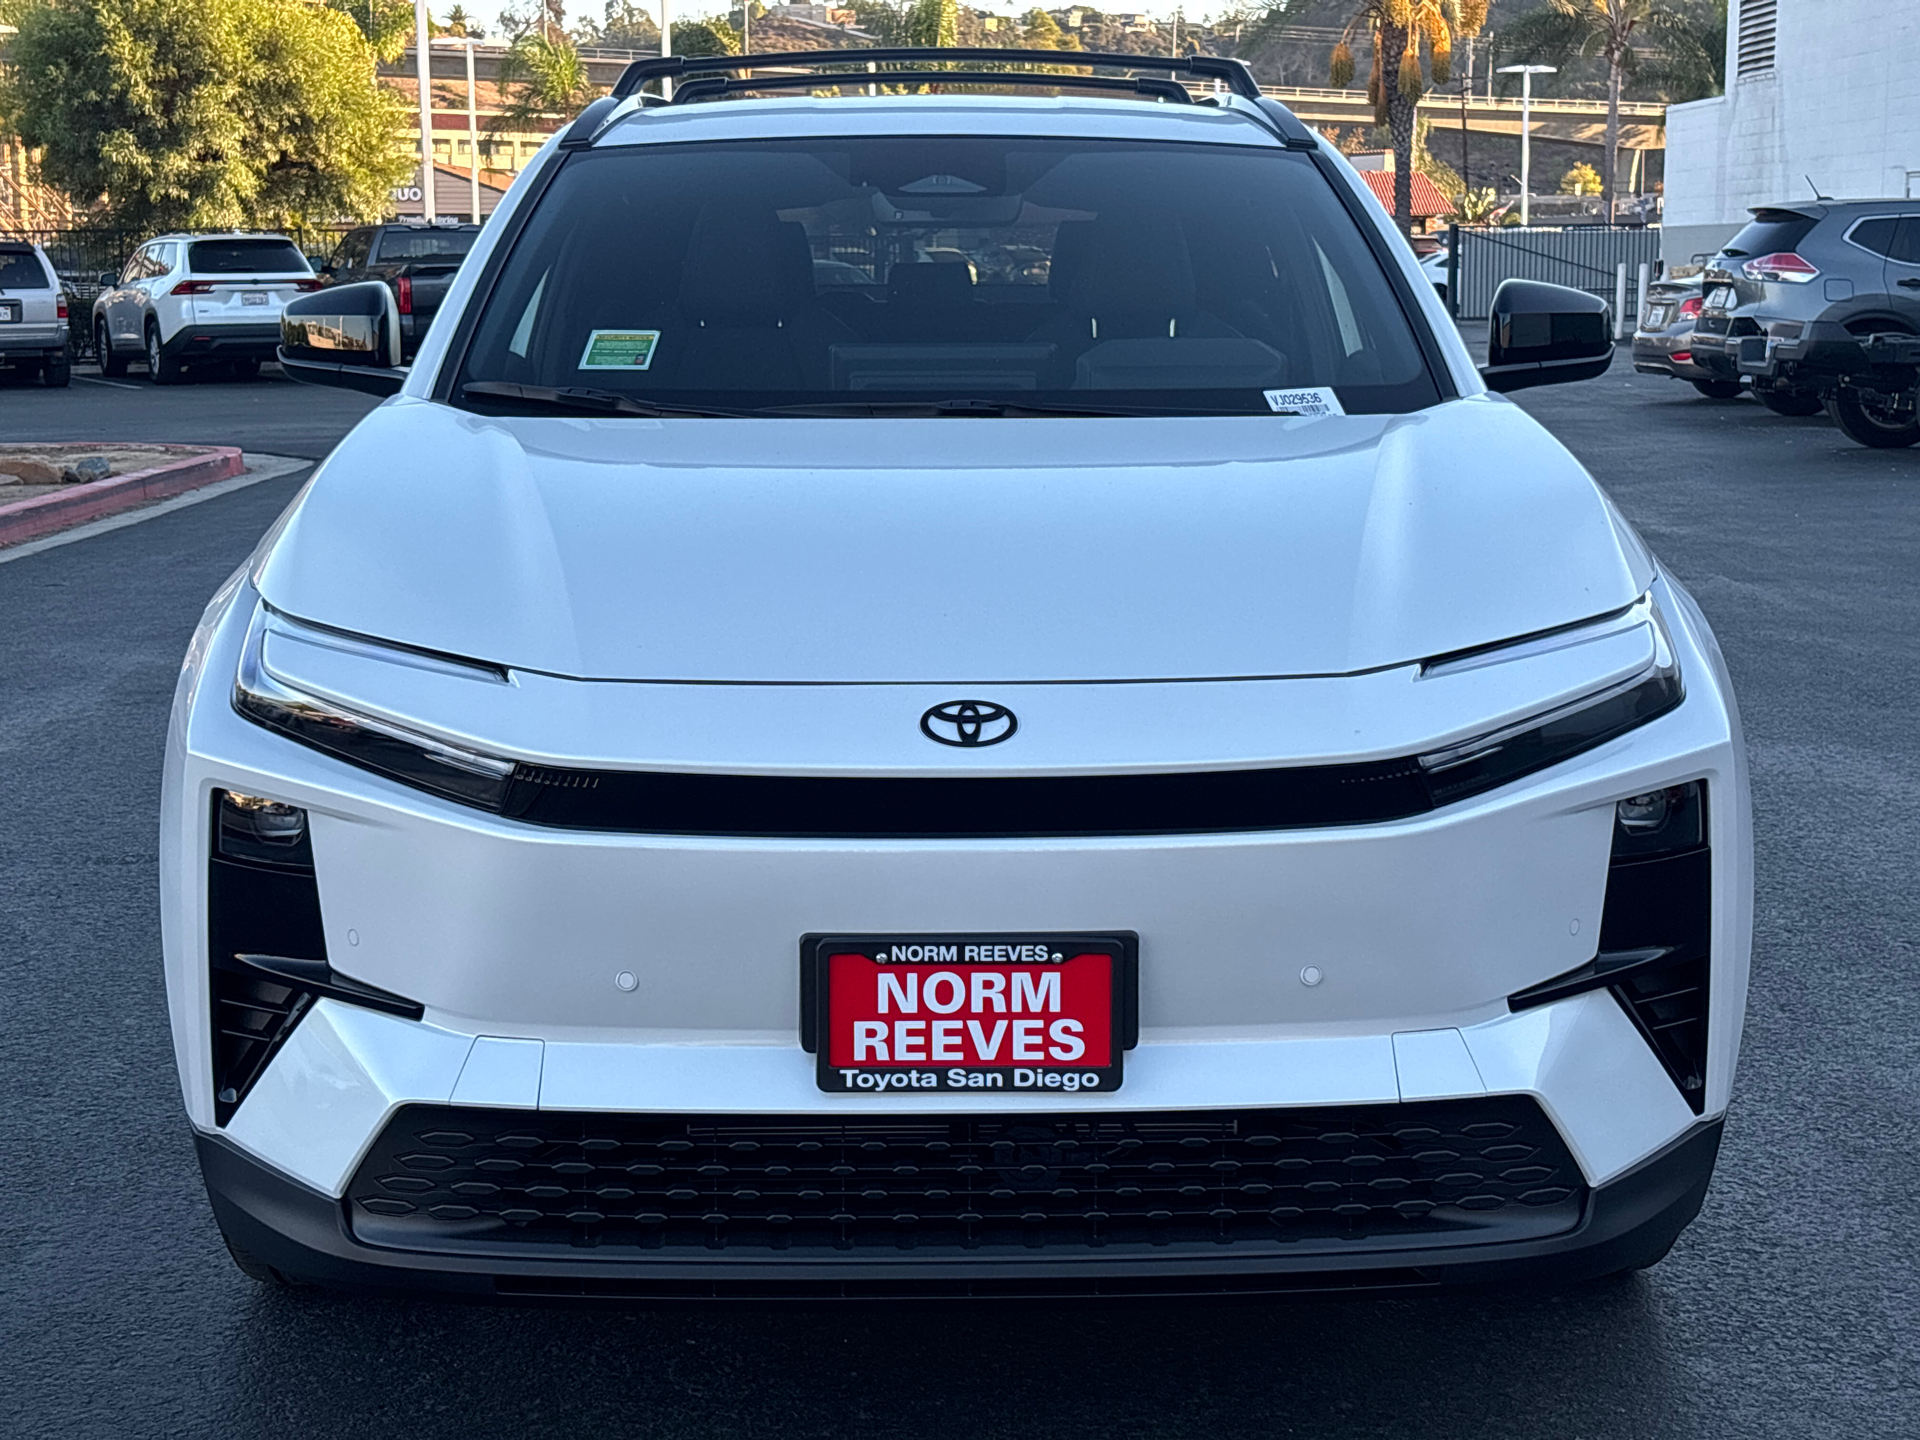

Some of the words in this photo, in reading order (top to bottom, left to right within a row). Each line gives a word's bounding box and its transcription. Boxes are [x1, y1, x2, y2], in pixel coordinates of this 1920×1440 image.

[1270, 392, 1322, 406] VJ029536
[891, 945, 956, 962] NORM
[964, 945, 1048, 962] REEVES
[877, 971, 1061, 1014] NORM
[853, 1018, 1086, 1062] REEVES
[839, 1069, 938, 1092] Toyota
[946, 1068, 1003, 1088] San
[1013, 1068, 1100, 1091] Diego
